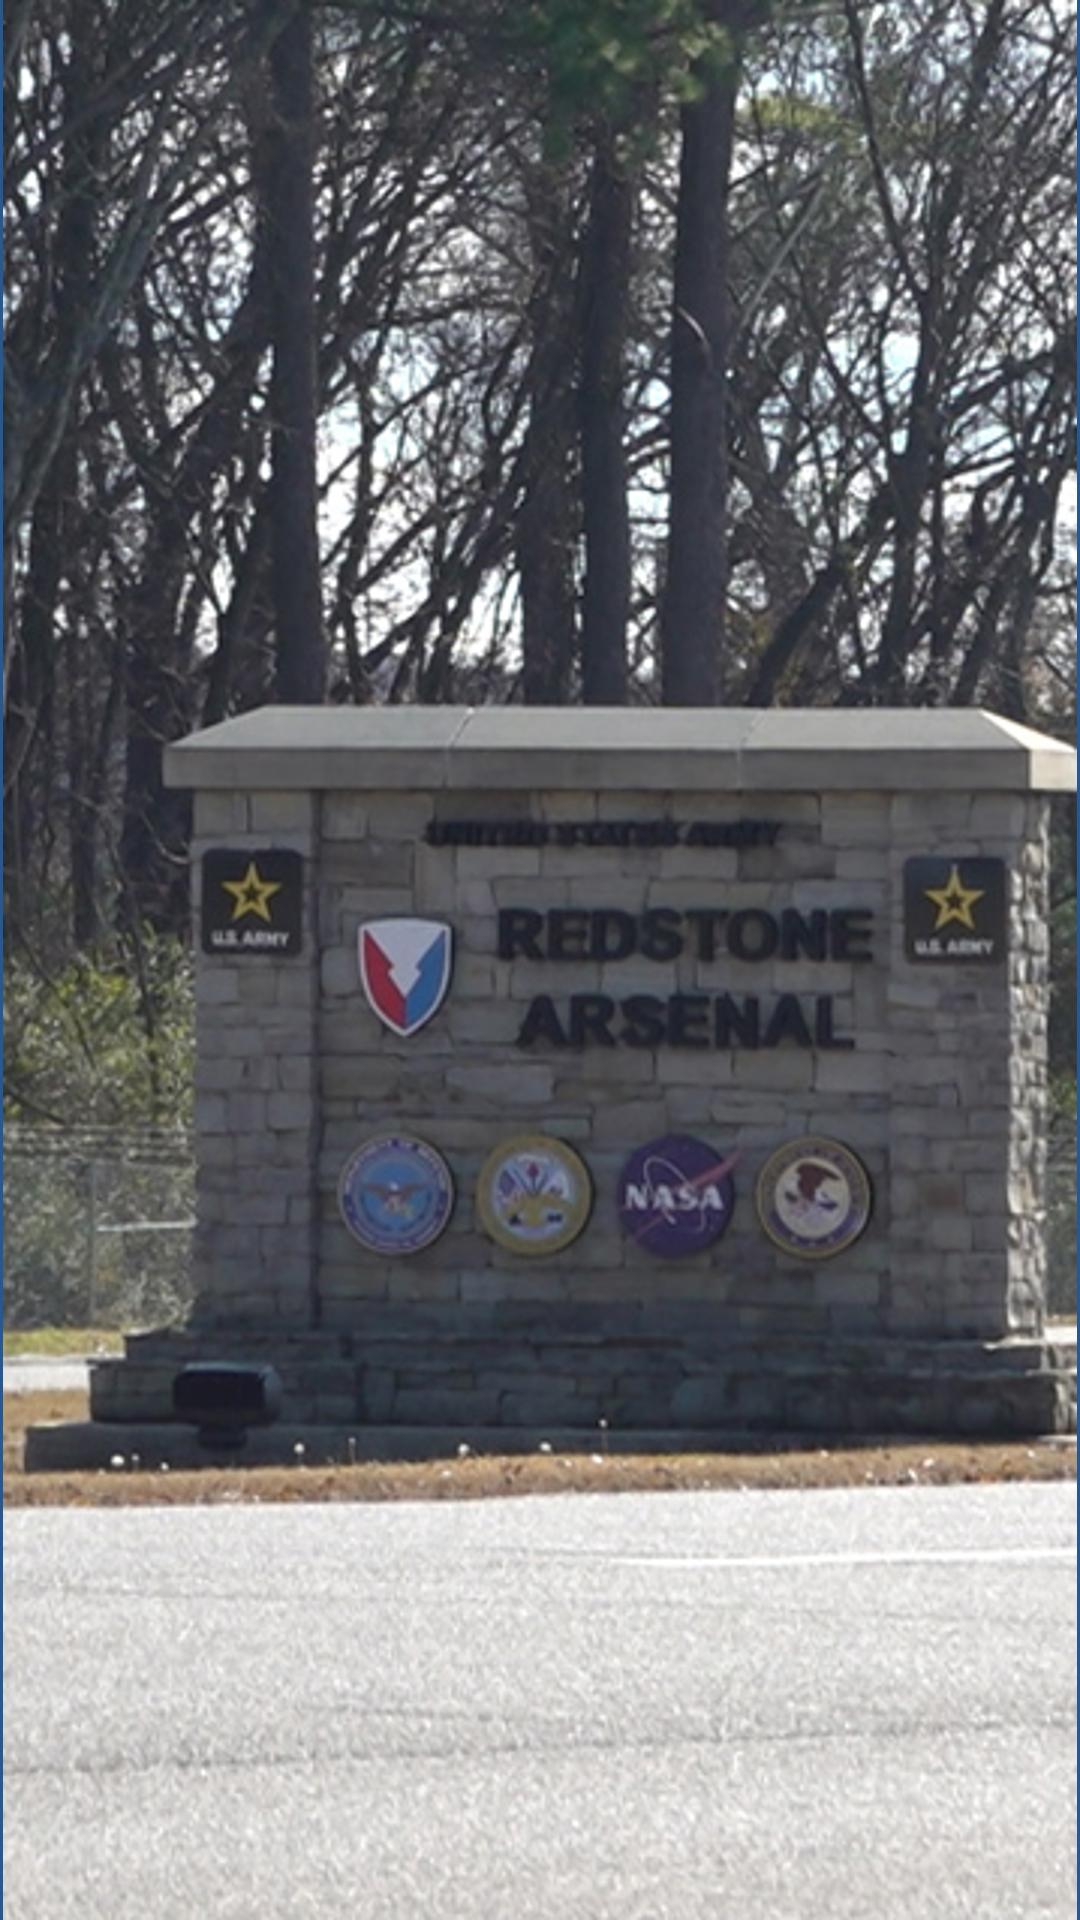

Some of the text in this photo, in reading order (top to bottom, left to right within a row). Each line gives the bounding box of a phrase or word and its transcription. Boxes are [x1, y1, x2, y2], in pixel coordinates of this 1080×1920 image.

[243, 930, 289, 947] ARMY
[497, 907, 874, 962] REDSTONE
[946, 939, 993, 955] ARMY
[516, 993, 855, 1049] ARSENAL
[625, 1184, 724, 1211] NASA
